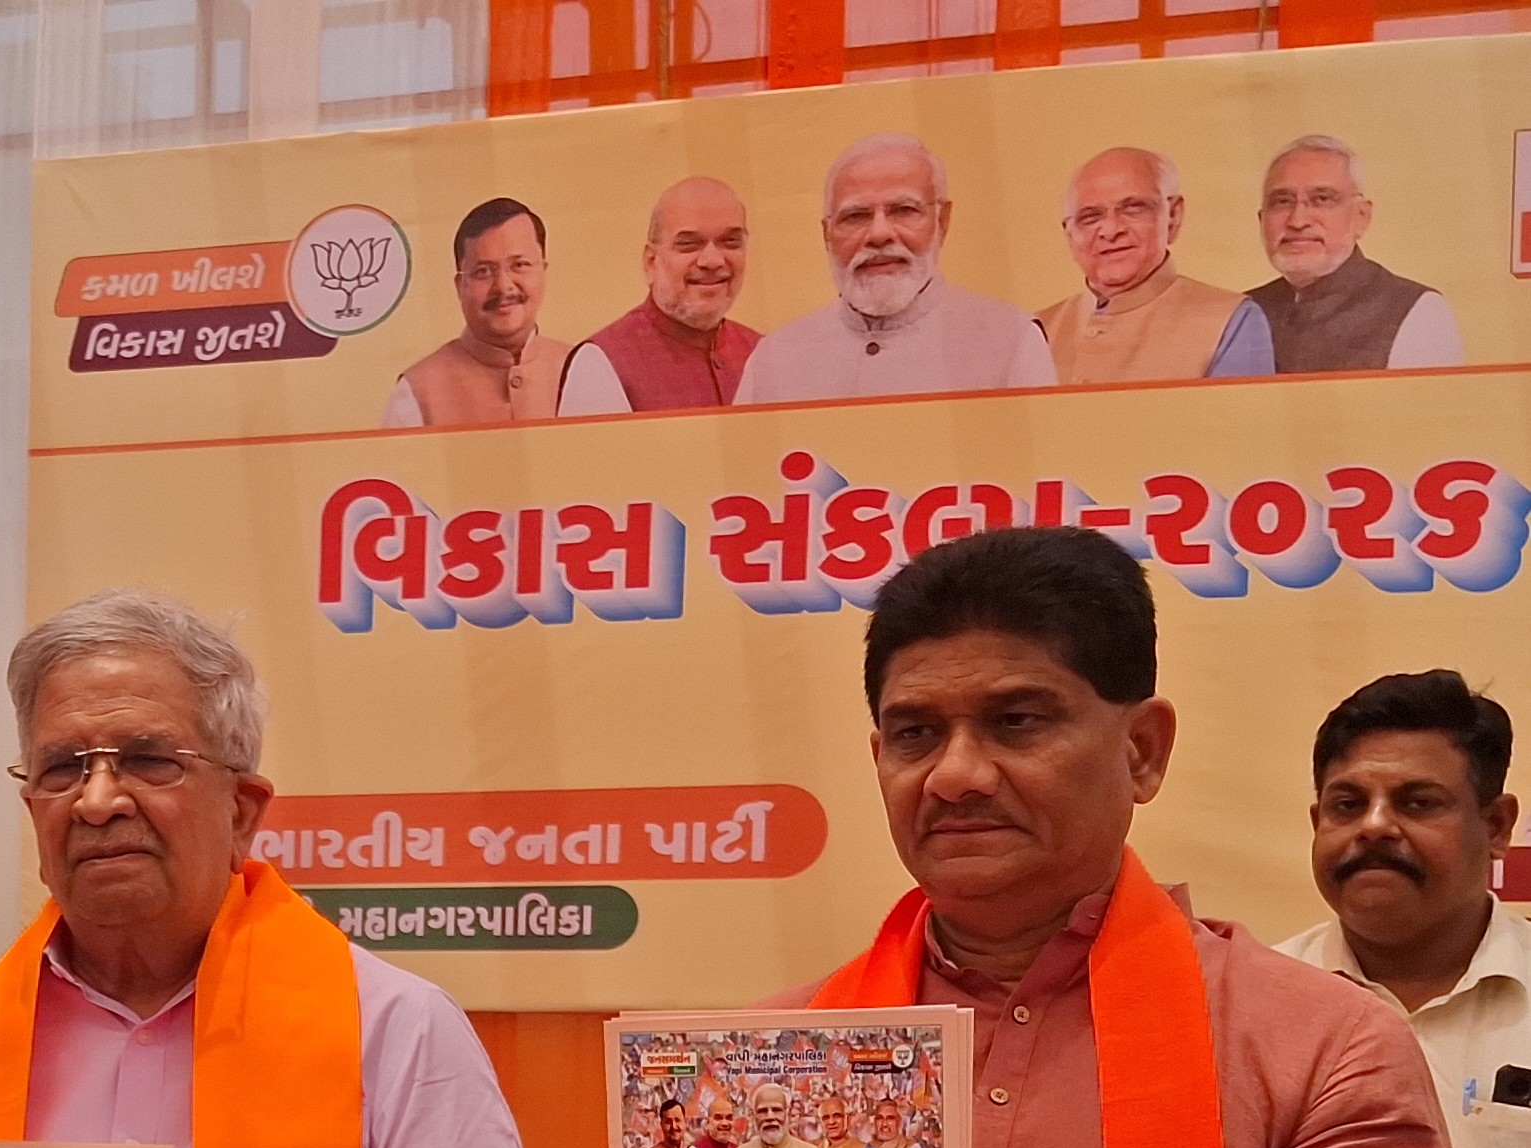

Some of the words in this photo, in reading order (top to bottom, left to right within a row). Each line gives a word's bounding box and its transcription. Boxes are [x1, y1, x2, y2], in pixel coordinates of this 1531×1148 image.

[81, 271, 159, 302] કમળ
[172, 252, 266, 293] ખીલશે
[84, 323, 185, 361] વિકાસ
[194, 310, 286, 362] જીતશે
[317, 477, 656, 606] વિકાસ
[250, 811, 445, 868] ભારતીય
[467, 823, 622, 867] જનતા
[644, 801, 775, 865] પાર્ટી
[337, 893, 594, 940] મહાનગરપાલિકા
[726, 1049, 749, 1062] વાપી
[727, 1066, 742, 1075] Vapi
[745, 1065, 781, 1075] Municipal
[783, 1065, 827, 1075] Corporation
